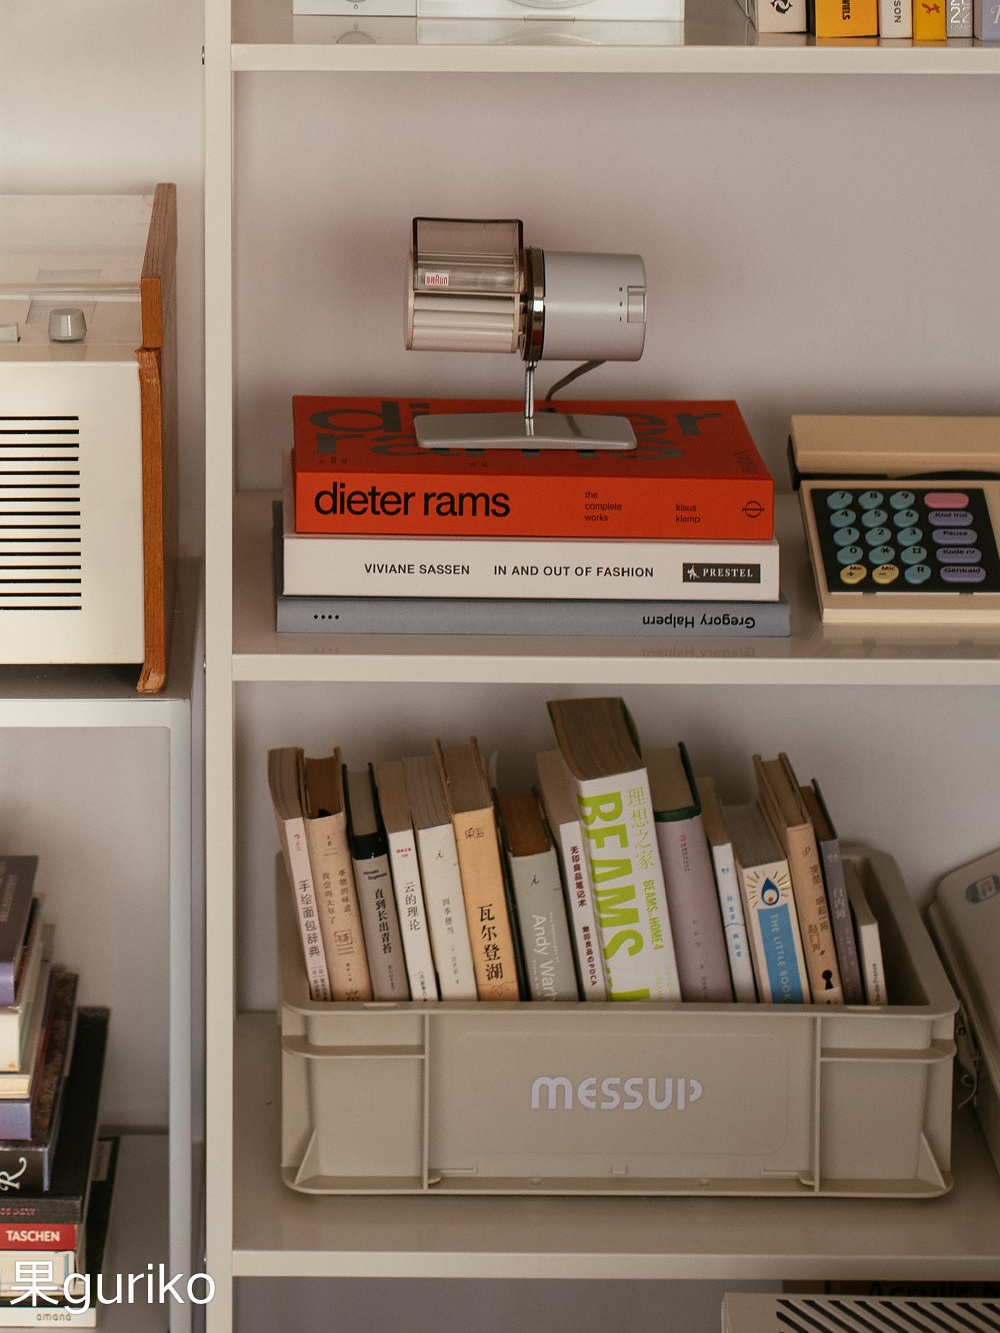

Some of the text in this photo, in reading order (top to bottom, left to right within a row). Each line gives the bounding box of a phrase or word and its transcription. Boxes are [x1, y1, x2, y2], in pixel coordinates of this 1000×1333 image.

[426, 274, 449, 285] BRAUN
[315, 482, 510, 517] dieter rams
[585, 503, 622, 511] complete
[675, 503, 697, 512] klaus
[675, 516, 701, 524] klemp
[364, 563, 470, 575] VIVIANE SASSEN
[494, 565, 654, 578] IN AND OUT OF FASHION
[702, 568, 753, 579] PRESTEL
[642, 614, 756, 629] Gregory Halpern
[627, 786, 654, 871] 理想之家
[578, 789, 645, 961] BEAMS
[643, 879, 658, 913] BEAMS
[403, 882, 420, 931] 云的理论
[477, 904, 504, 981] 瓦尔登湖
[532, 915, 551, 956] Andy
[769, 913, 792, 1000] THE LITTLE BOOK
[6, 1230, 60, 1243] TASCHEN
